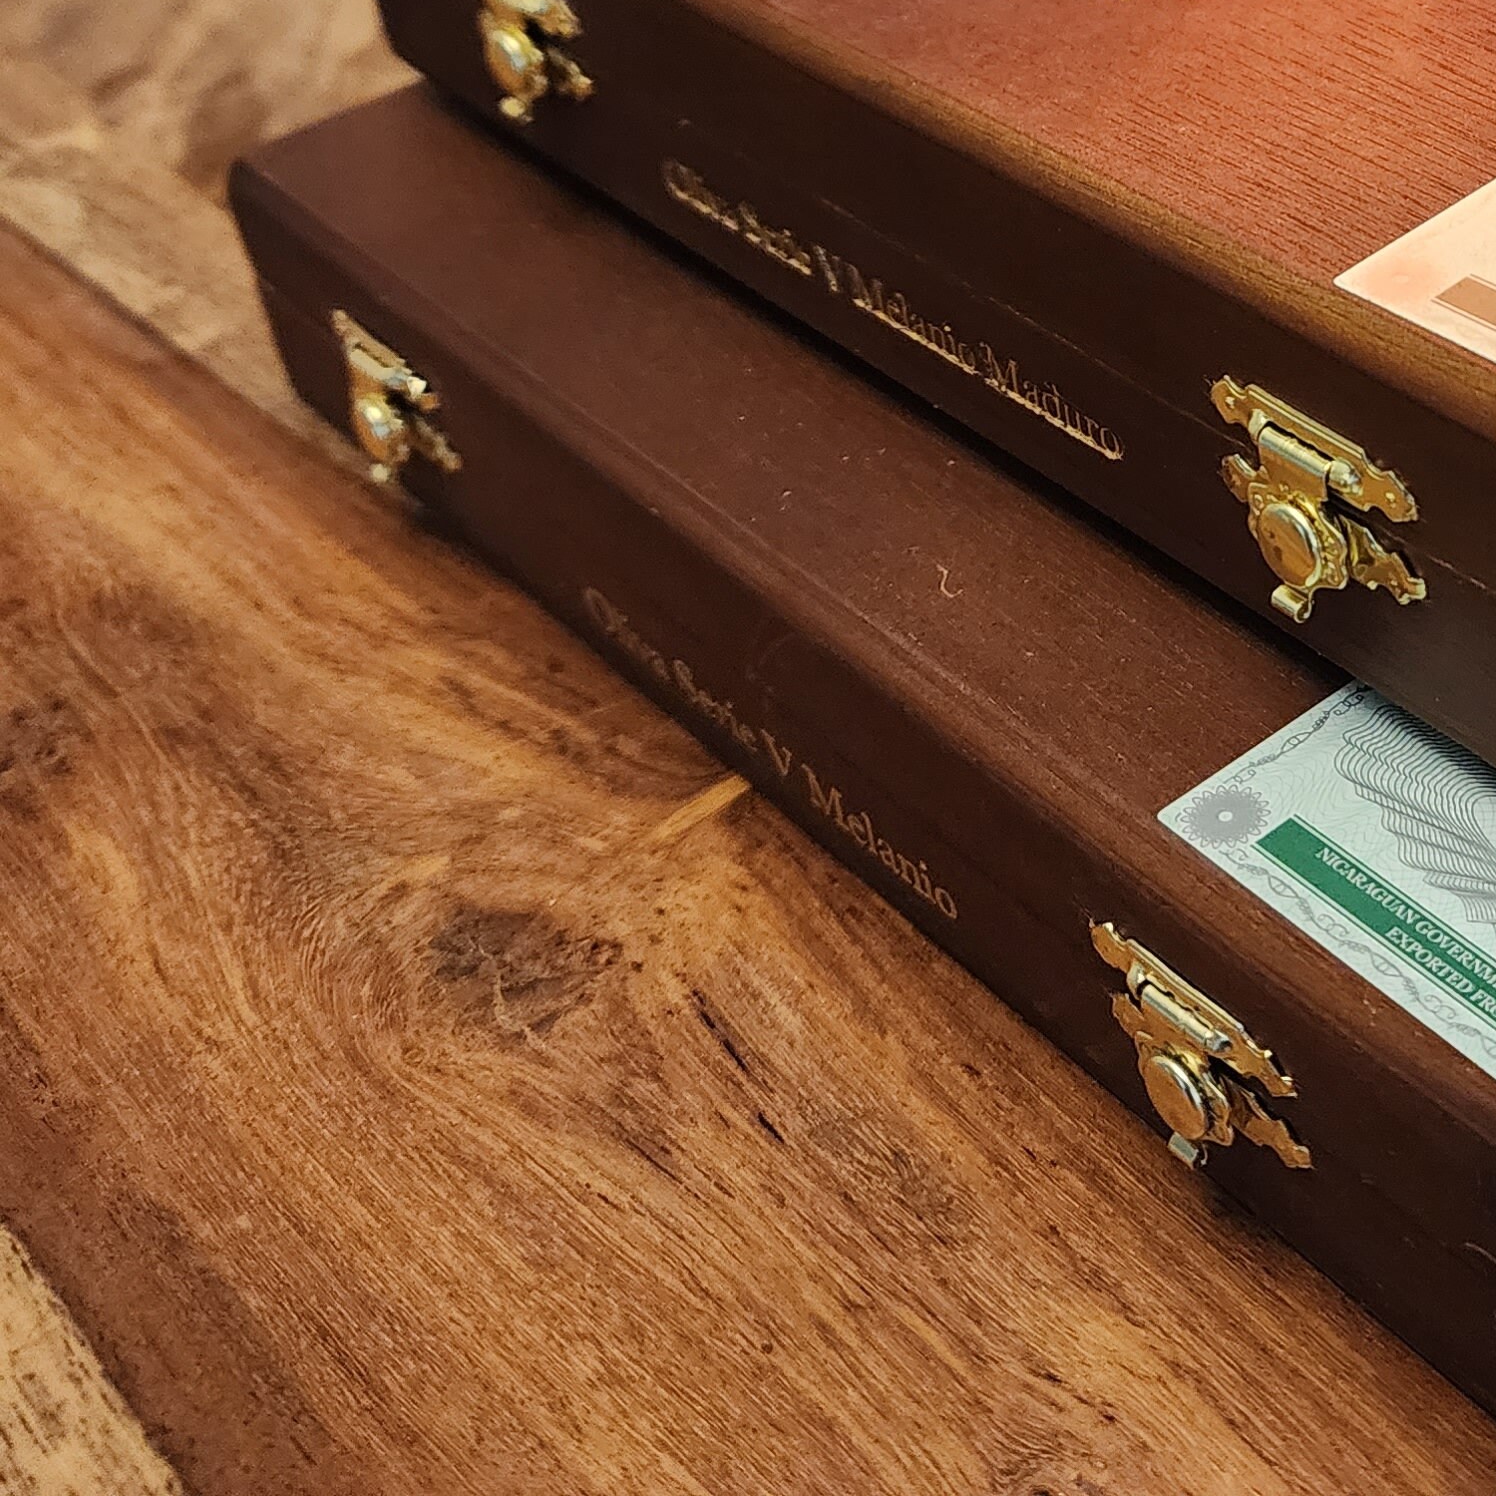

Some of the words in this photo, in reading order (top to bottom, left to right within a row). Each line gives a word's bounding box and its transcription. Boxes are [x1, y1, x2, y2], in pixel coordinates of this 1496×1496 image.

[979, 341, 1125, 461] Maduro
[760, 728, 792, 776] V
[801, 763, 958, 919] Melanio
[1315, 847, 1417, 931] NICARAGUAN
[1385, 925, 1475, 1001] EXPORTED
